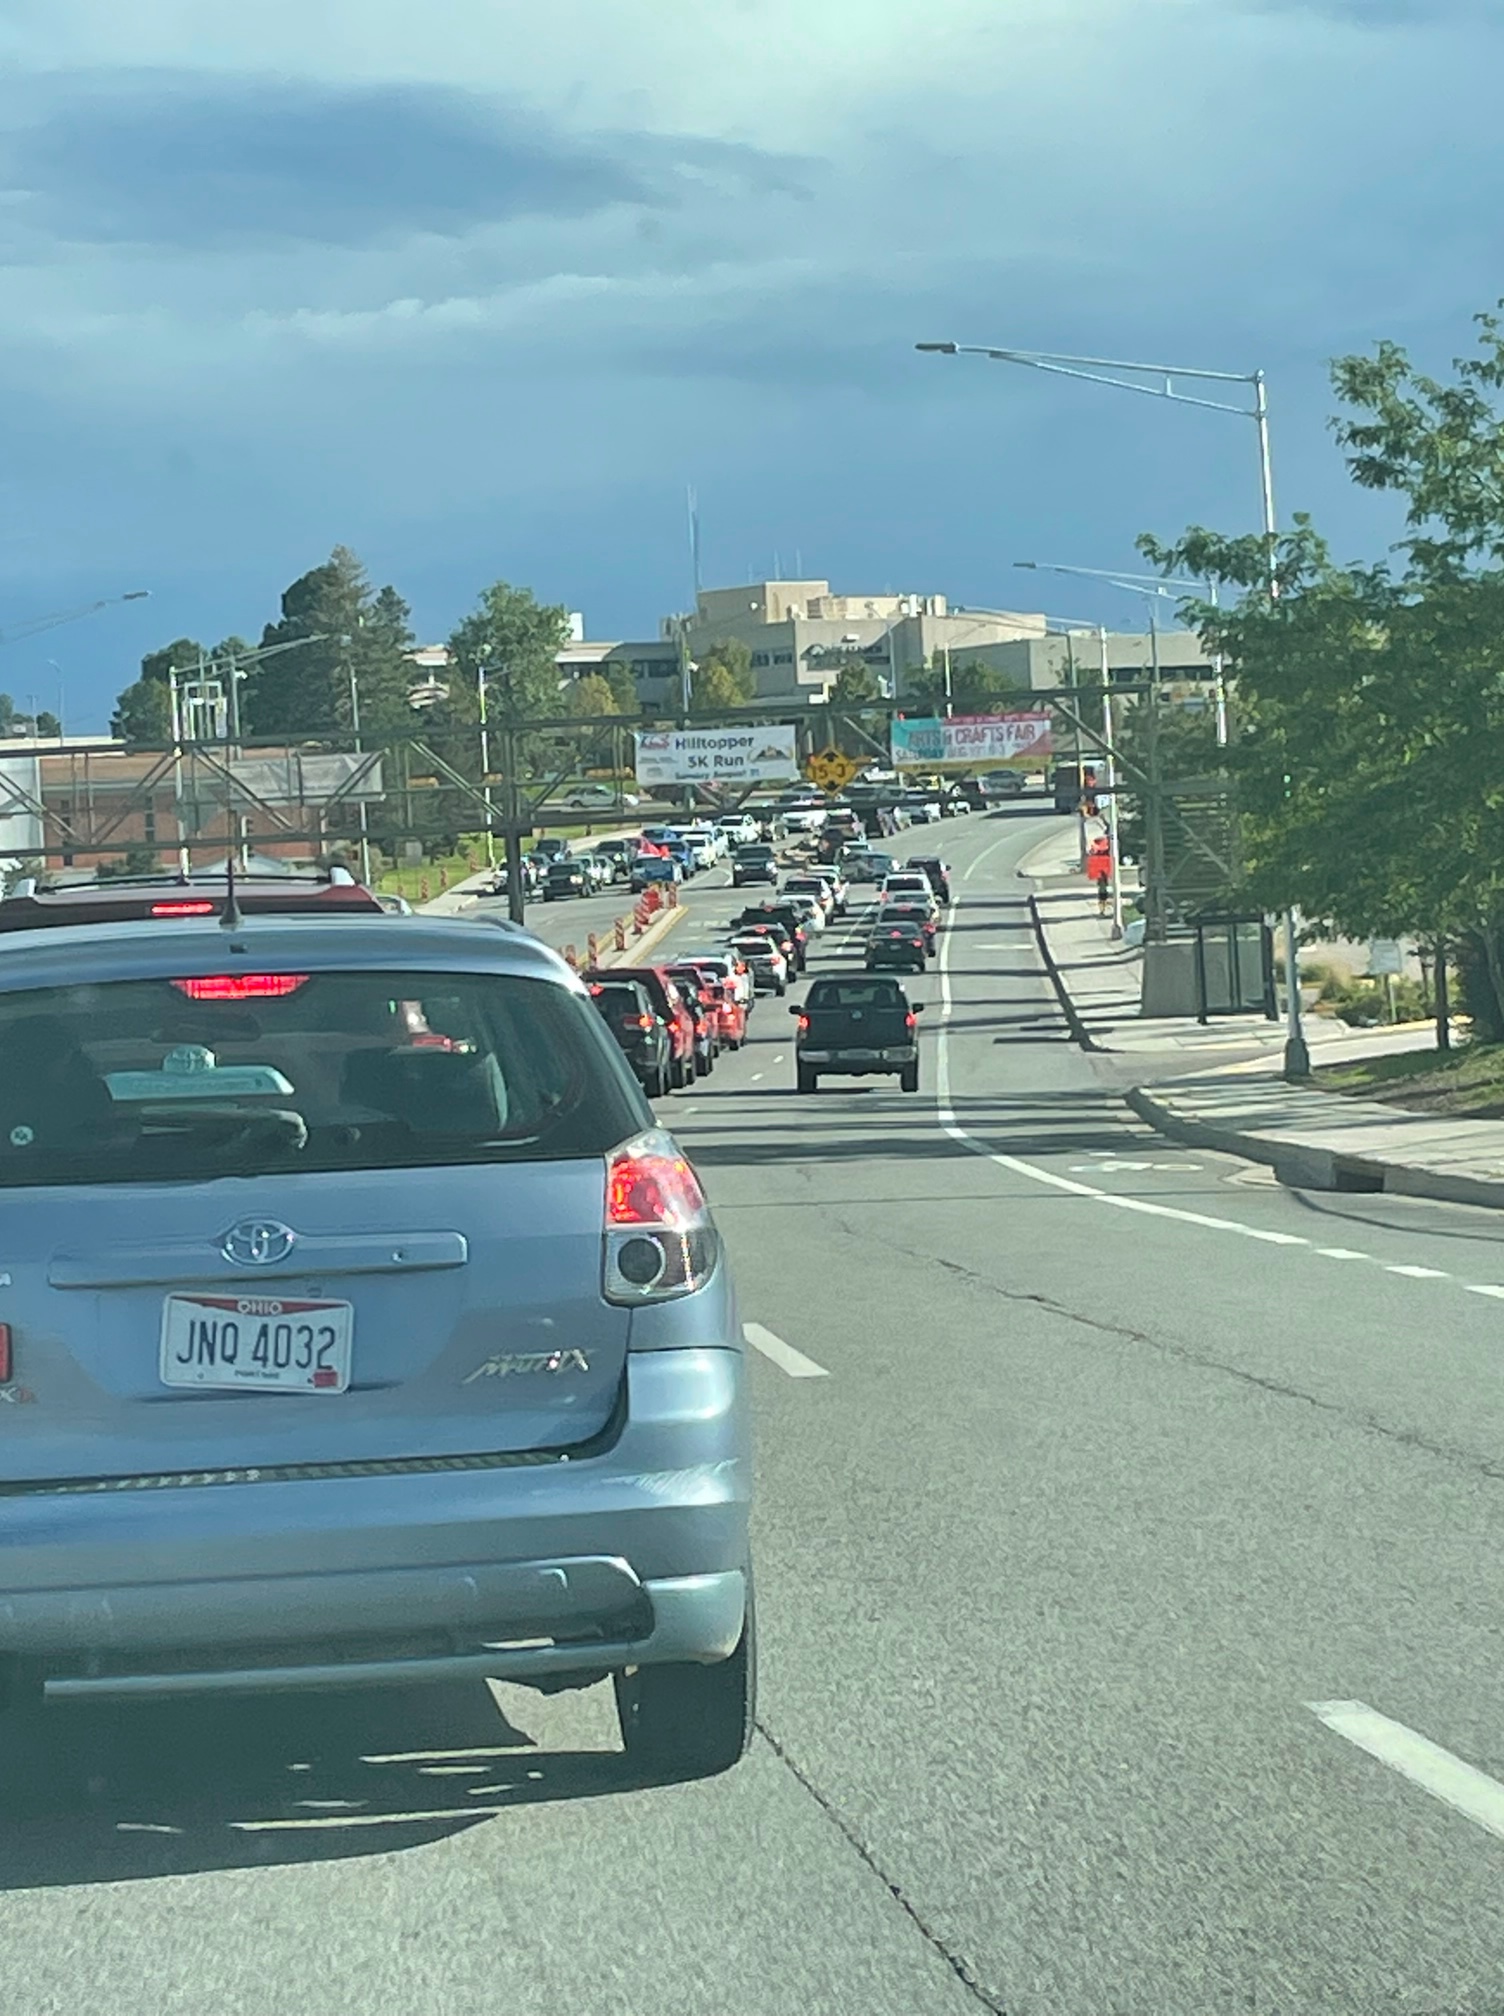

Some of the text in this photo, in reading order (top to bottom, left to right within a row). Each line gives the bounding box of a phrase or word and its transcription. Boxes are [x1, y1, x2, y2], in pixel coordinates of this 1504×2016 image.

[908, 729, 941, 746] ARTS
[955, 726, 1004, 745] CRAFTS
[1006, 723, 1036, 742] FAIR
[675, 736, 755, 750] Hilltopper
[688, 755, 708, 768] 5K
[713, 753, 745, 767] Run
[237, 1300, 282, 1315] OHIO
[176, 1319, 336, 1371] JNQ 4032
